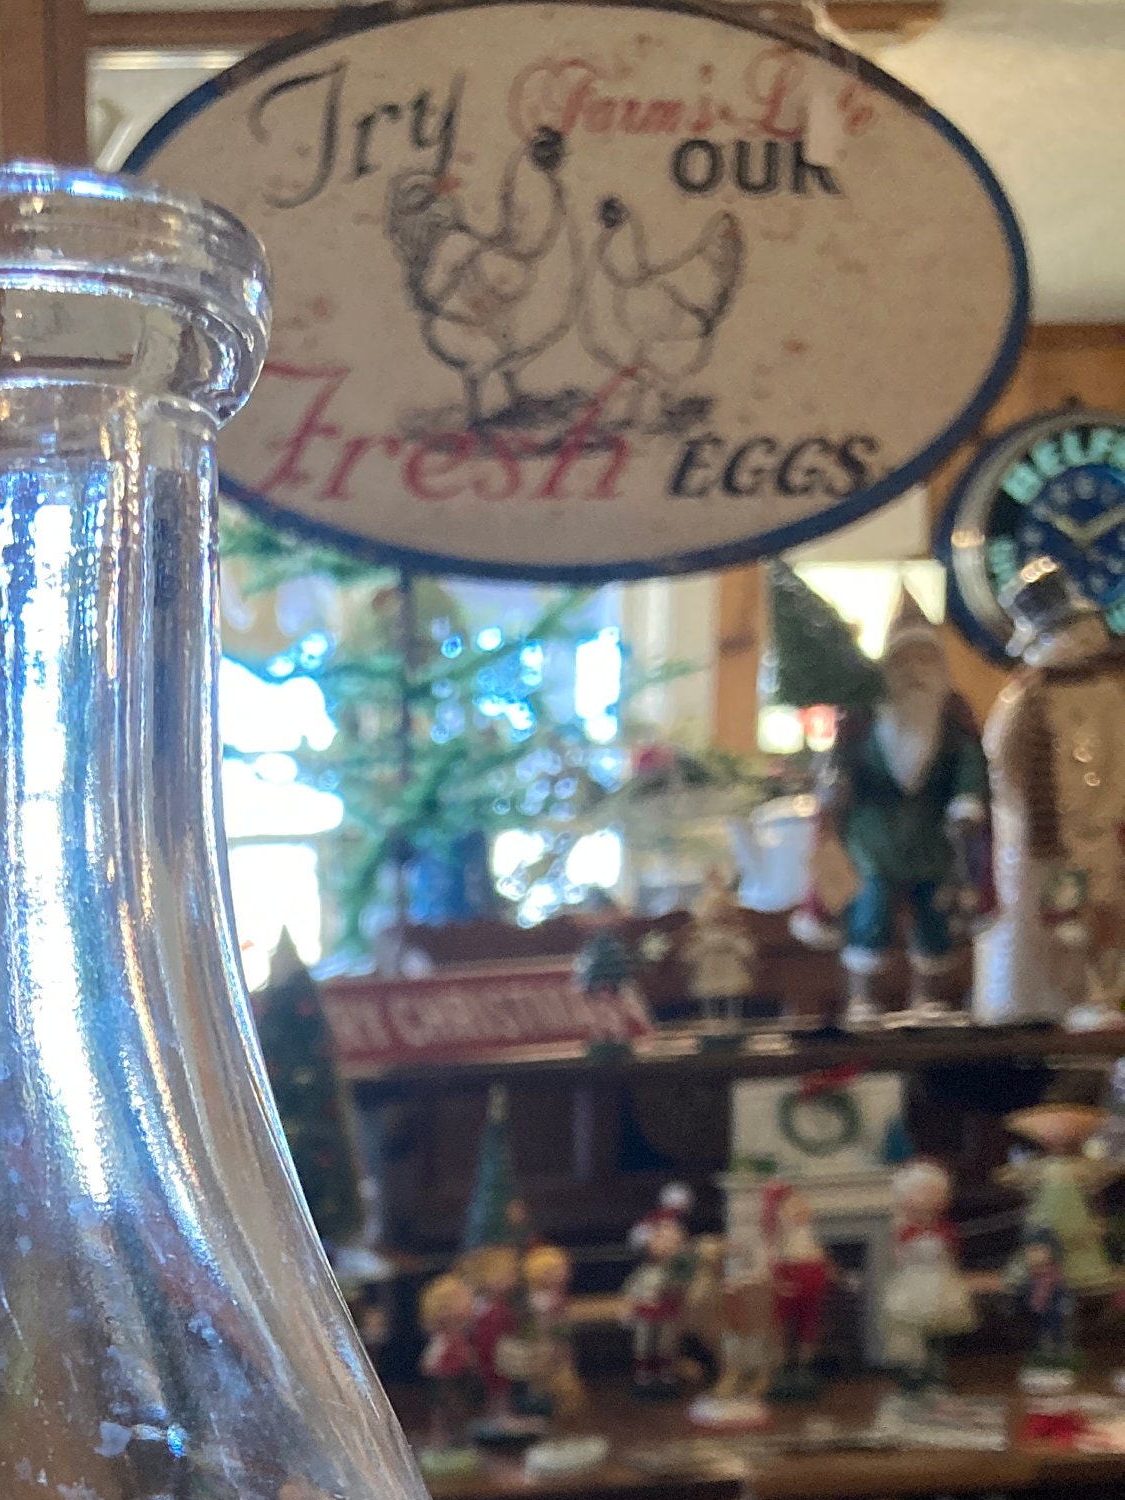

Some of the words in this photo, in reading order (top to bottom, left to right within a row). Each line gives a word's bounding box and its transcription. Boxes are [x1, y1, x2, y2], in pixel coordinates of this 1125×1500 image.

[248, 57, 467, 209] Try
[256, 360, 632, 502] Fresh
[663, 431, 881, 499] EGGS
